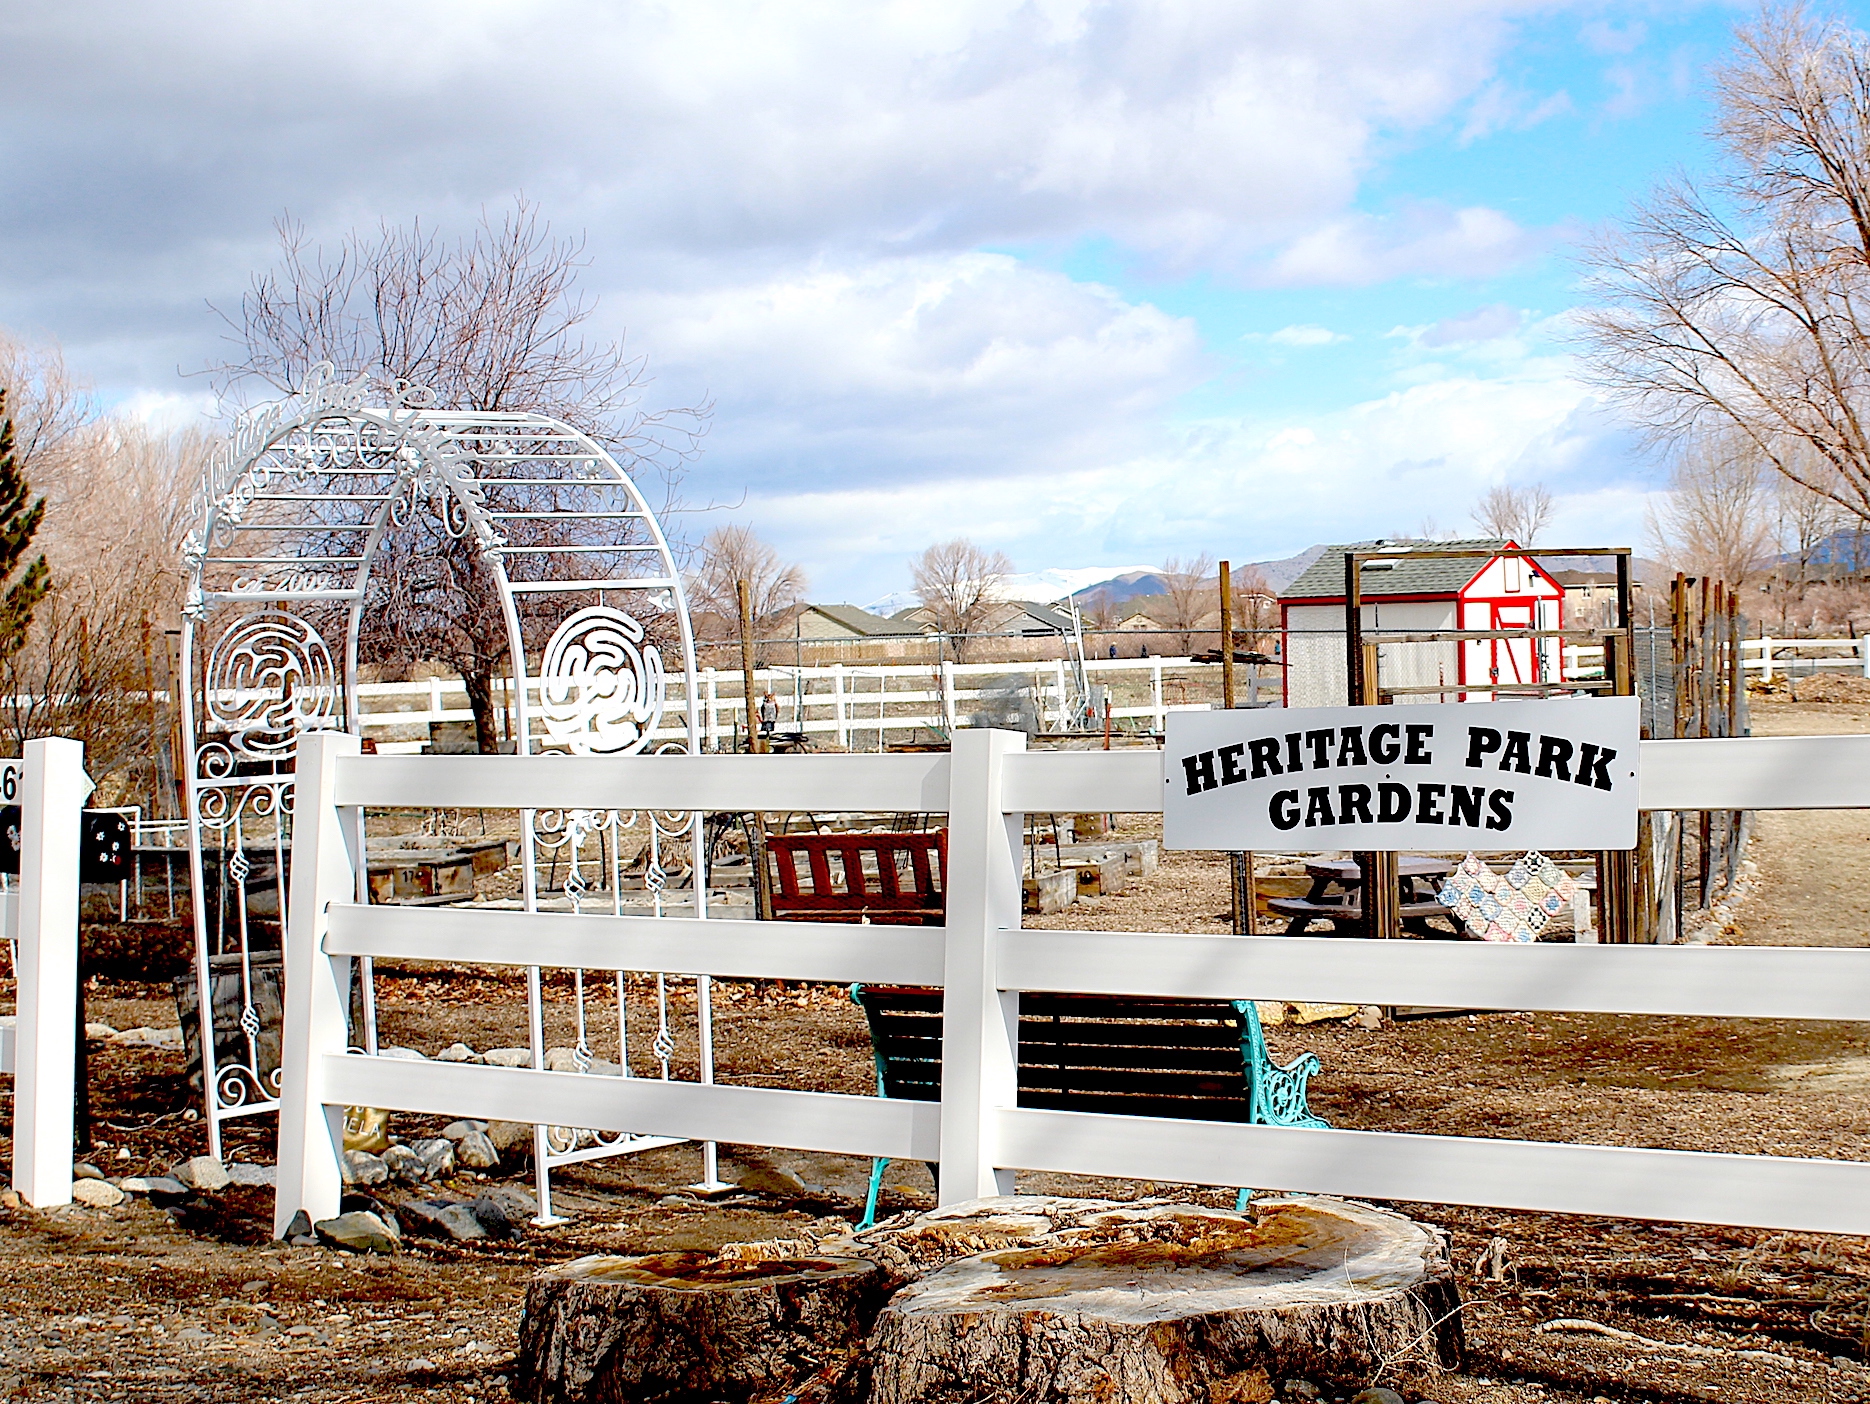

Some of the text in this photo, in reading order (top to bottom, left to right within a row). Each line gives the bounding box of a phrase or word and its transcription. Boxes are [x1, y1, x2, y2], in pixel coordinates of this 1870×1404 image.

[300, 360, 371, 413] Park
[1181, 723, 1618, 797] HERITAGE PARK
[1268, 782, 1515, 832] GARDENS
[402, 870, 414, 883] 17
